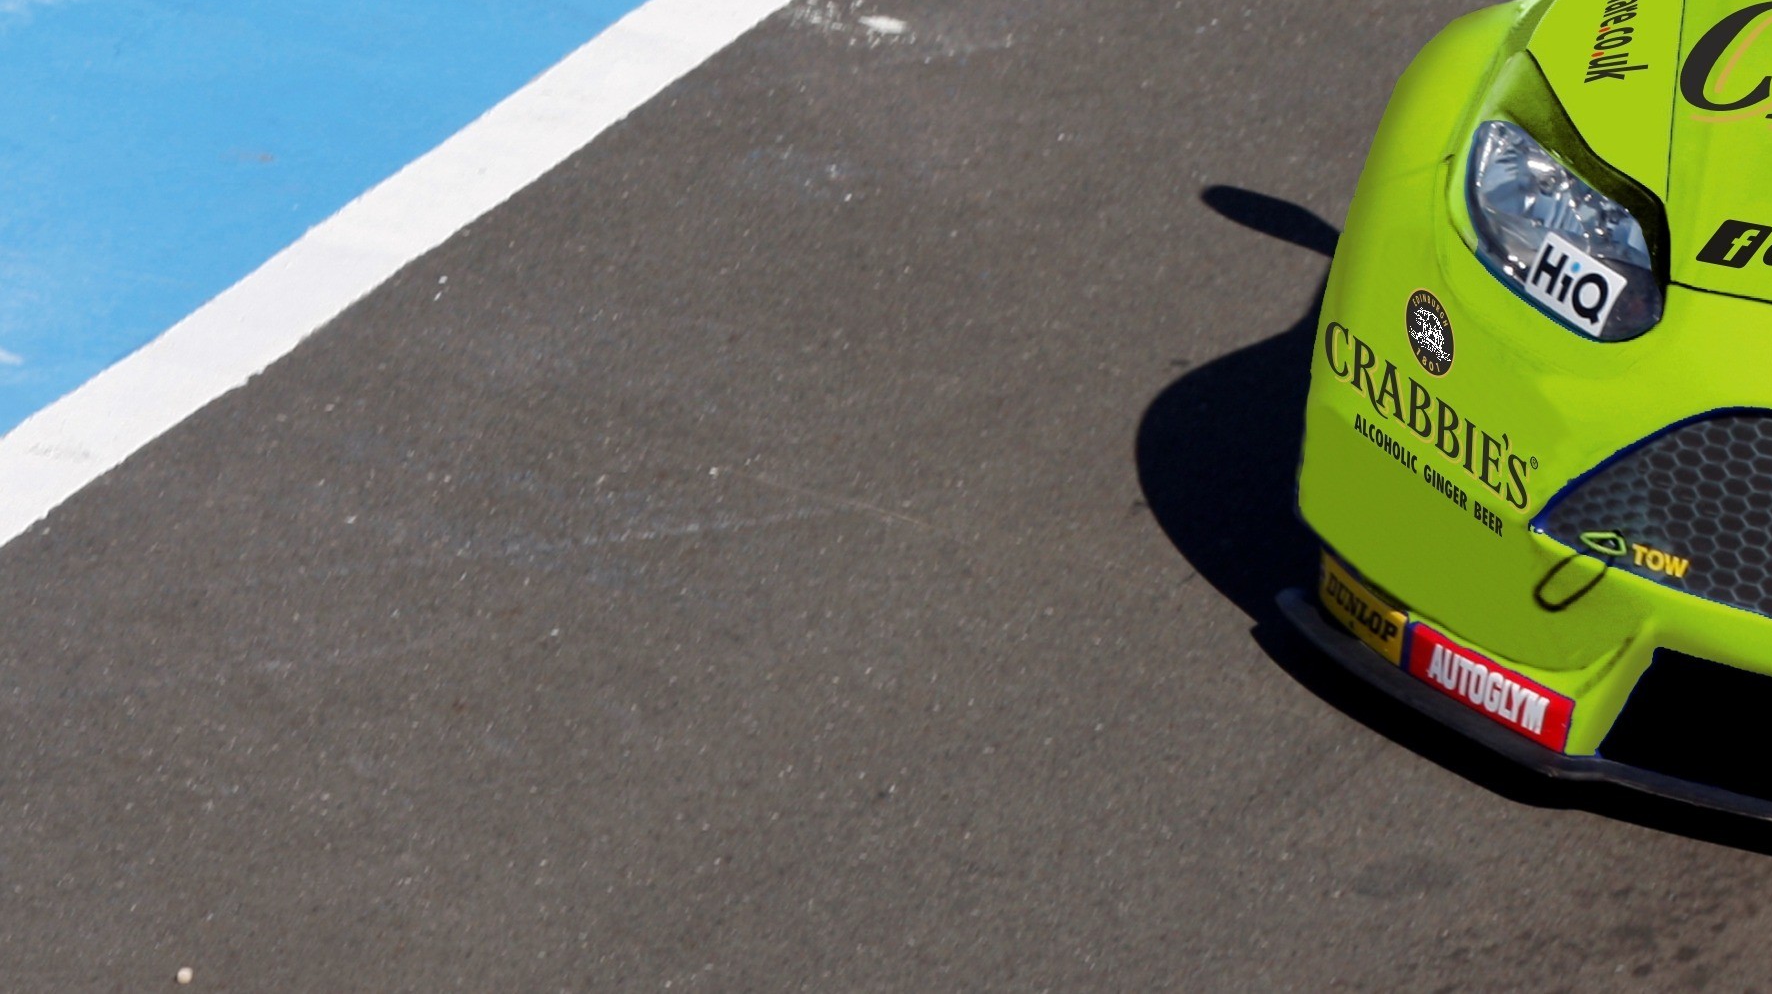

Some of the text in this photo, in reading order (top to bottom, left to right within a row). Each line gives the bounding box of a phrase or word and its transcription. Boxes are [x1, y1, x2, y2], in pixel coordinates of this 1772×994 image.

[1412, 291, 1448, 328] EDINBURGH
[1532, 244, 1610, 324] HiQ
[1415, 348, 1442, 373] 1801
[1325, 322, 1529, 510] CRABBIE'S
[1354, 413, 1503, 538] ALCOHOLIC GINGER BEER
[1632, 543, 1689, 579] TOW
[1326, 571, 1398, 643] DUNLOP
[1427, 643, 1551, 735] AUTOGLYM
